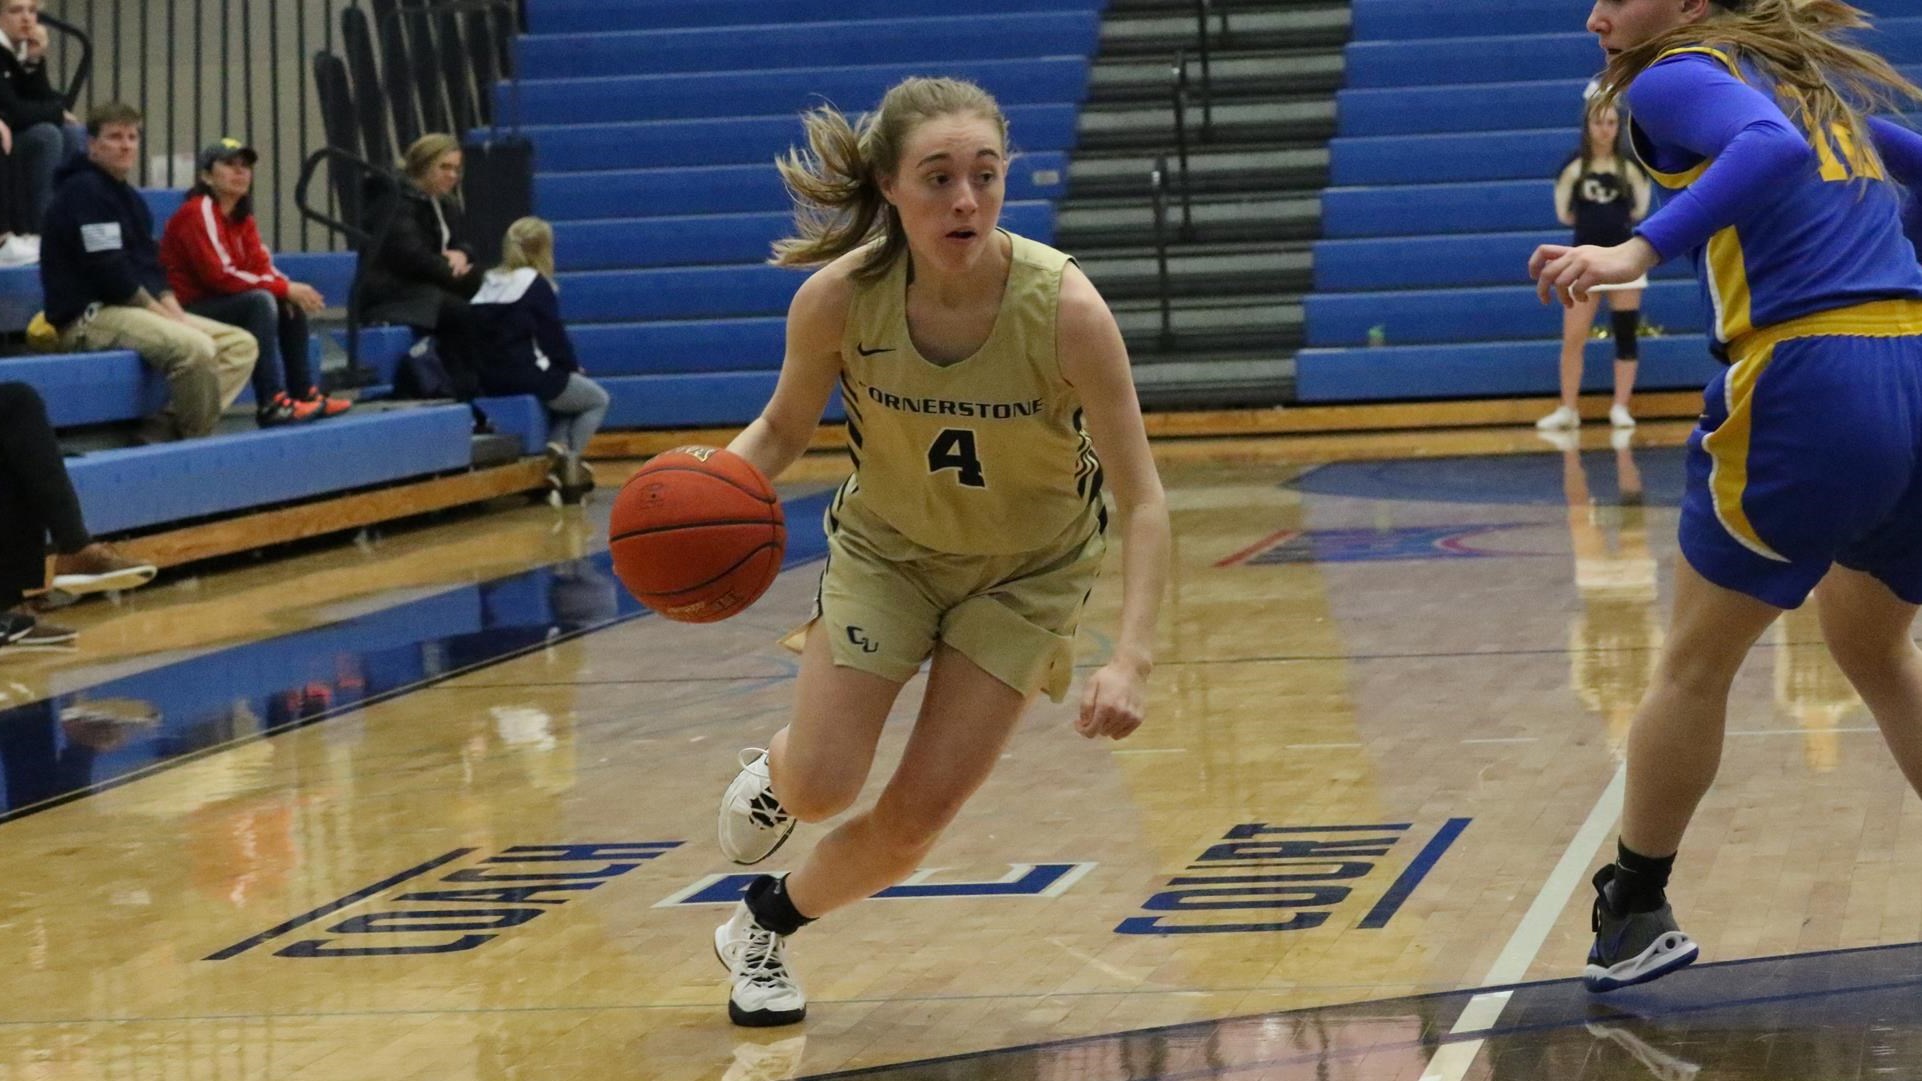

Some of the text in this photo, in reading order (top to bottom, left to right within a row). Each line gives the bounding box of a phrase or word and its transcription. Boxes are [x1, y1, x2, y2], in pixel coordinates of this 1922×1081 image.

[859, 380, 1044, 419] ORNERSTONE
[927, 427, 985, 489] 4
[846, 625, 879, 653] CU
[272, 841, 686, 958] COACH
[1113, 822, 1413, 934] COURT
